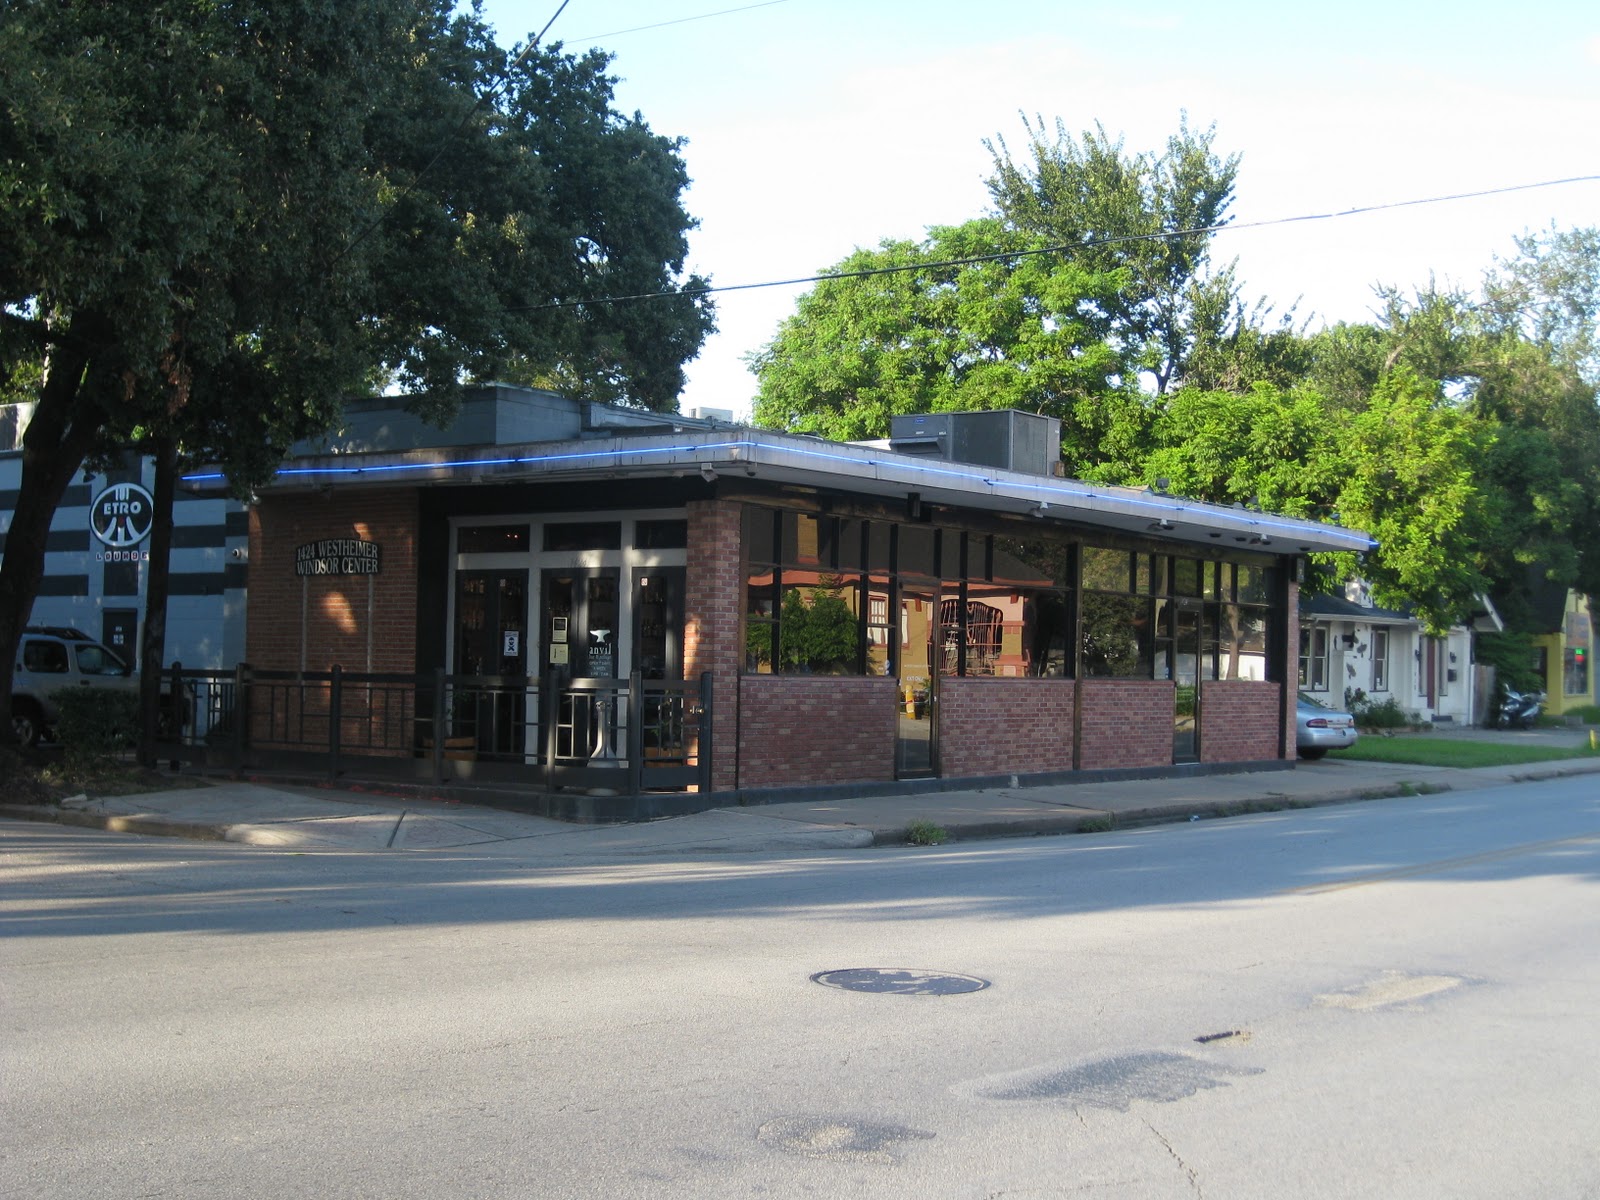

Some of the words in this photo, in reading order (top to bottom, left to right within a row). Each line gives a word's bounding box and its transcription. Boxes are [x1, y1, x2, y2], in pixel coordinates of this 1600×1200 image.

[103, 501, 142, 515] ETRO
[297, 543, 315, 560] 1424
[318, 539, 378, 558] WESTHEIMER
[297, 557, 339, 575] WINDSOR
[341, 556, 378, 574] CENTER
[589, 642, 612, 655] anvil
